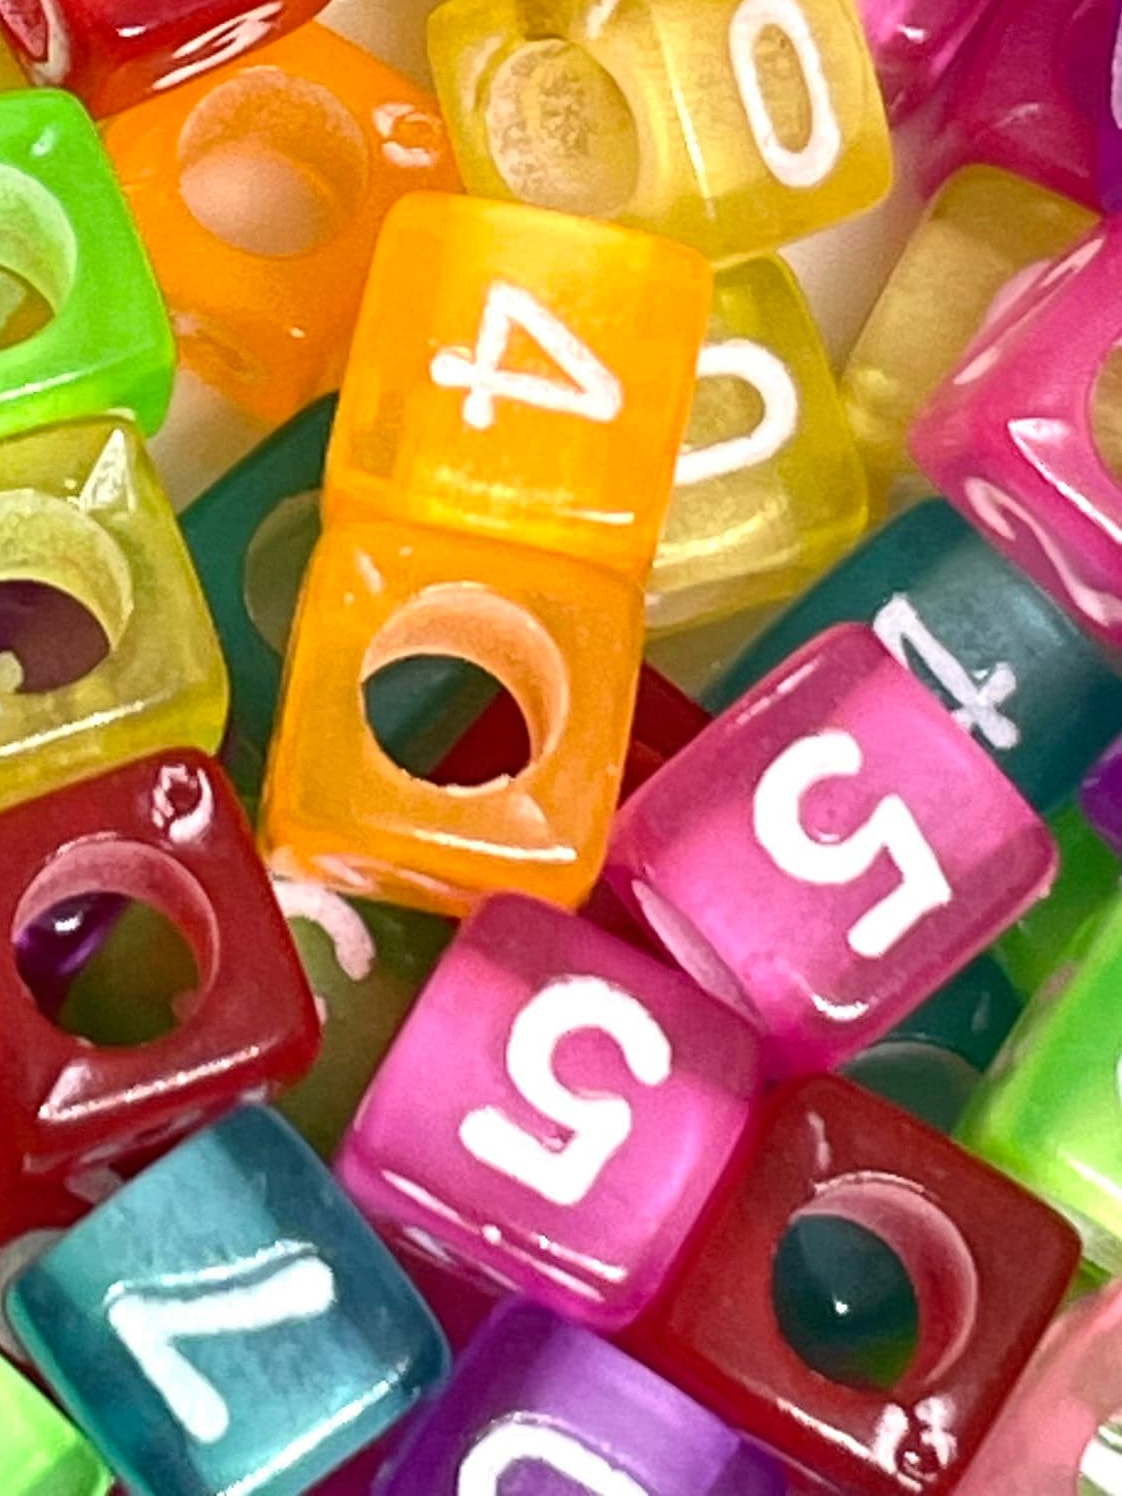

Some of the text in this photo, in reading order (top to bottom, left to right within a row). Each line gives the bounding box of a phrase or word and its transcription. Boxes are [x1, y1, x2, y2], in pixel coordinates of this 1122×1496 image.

[430, 282, 623, 430] 4
[754, 730, 952, 958] 5
[460, 974, 672, 1204] 5
[106, 1242, 336, 1444] 7
